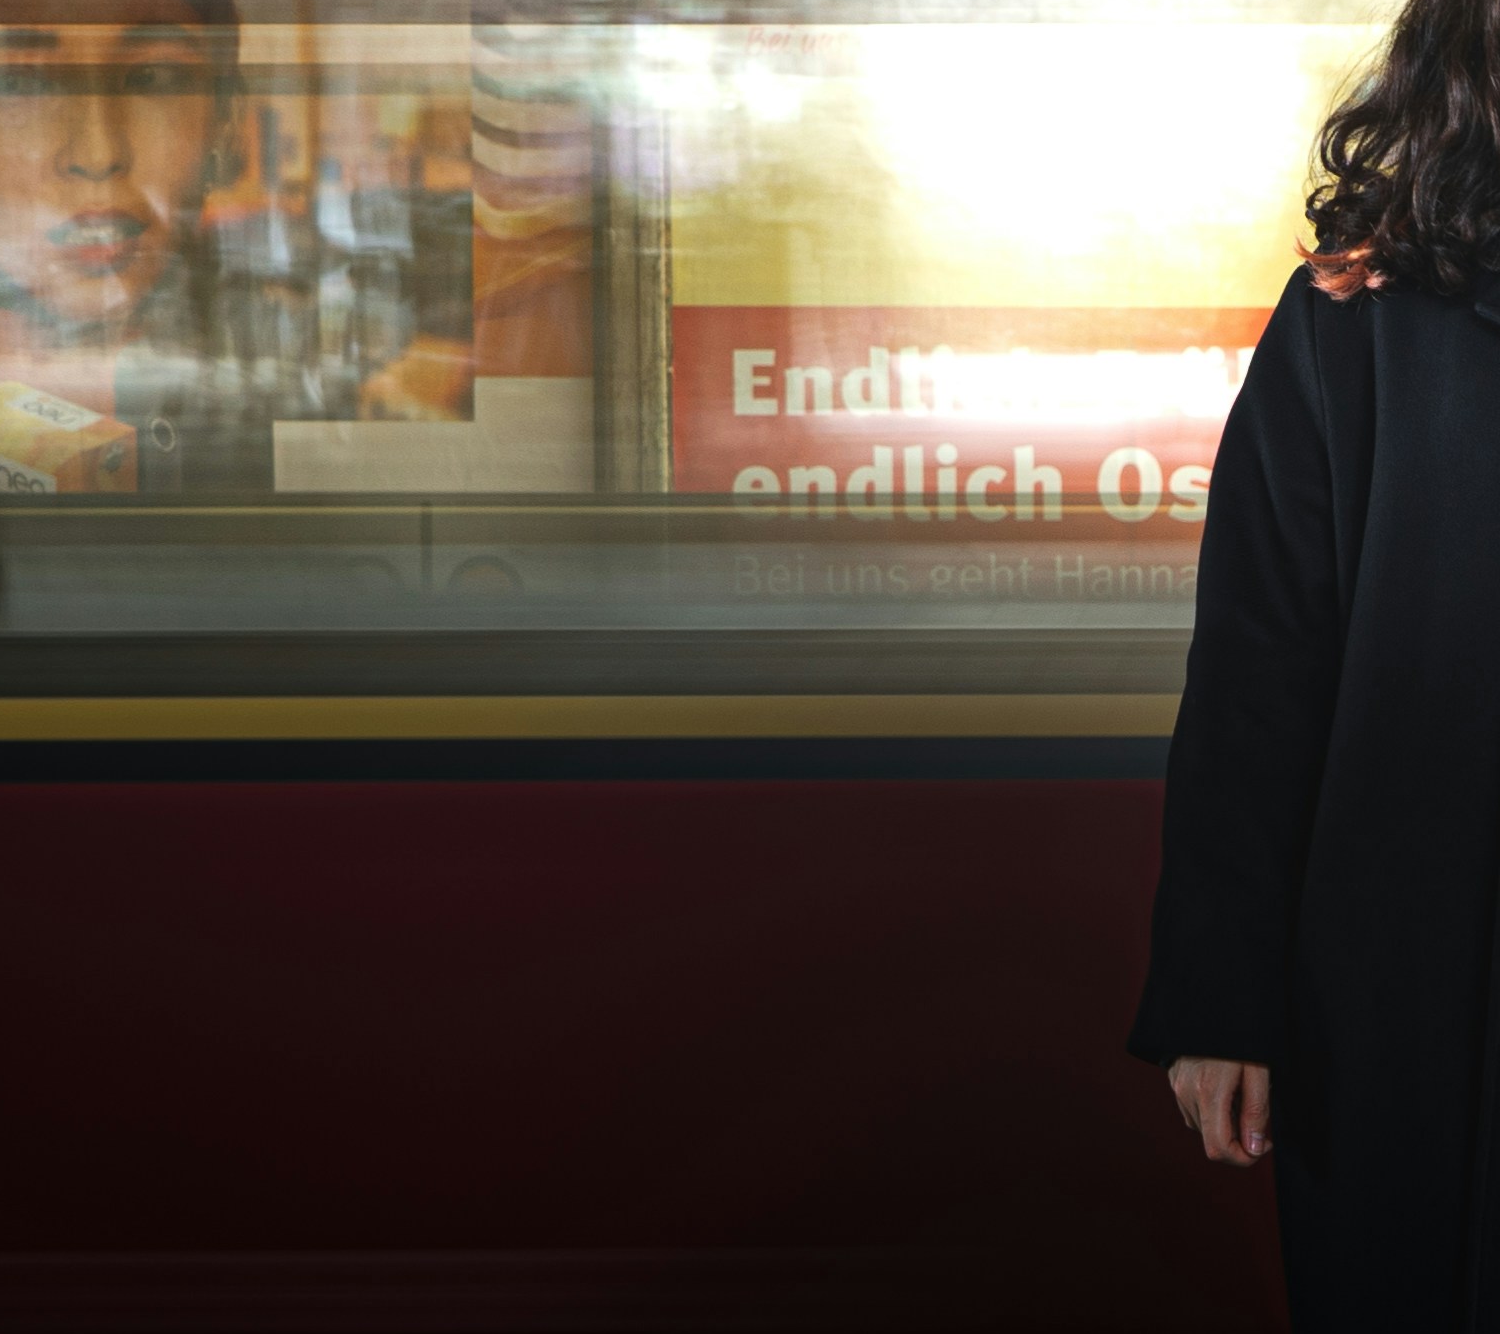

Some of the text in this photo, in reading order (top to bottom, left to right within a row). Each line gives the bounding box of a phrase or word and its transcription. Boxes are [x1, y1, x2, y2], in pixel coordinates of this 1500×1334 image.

[731, 442, 1063, 524] endlich
[733, 554, 805, 596] Bei
[827, 562, 908, 597] uns
[929, 553, 1031, 603] geht
